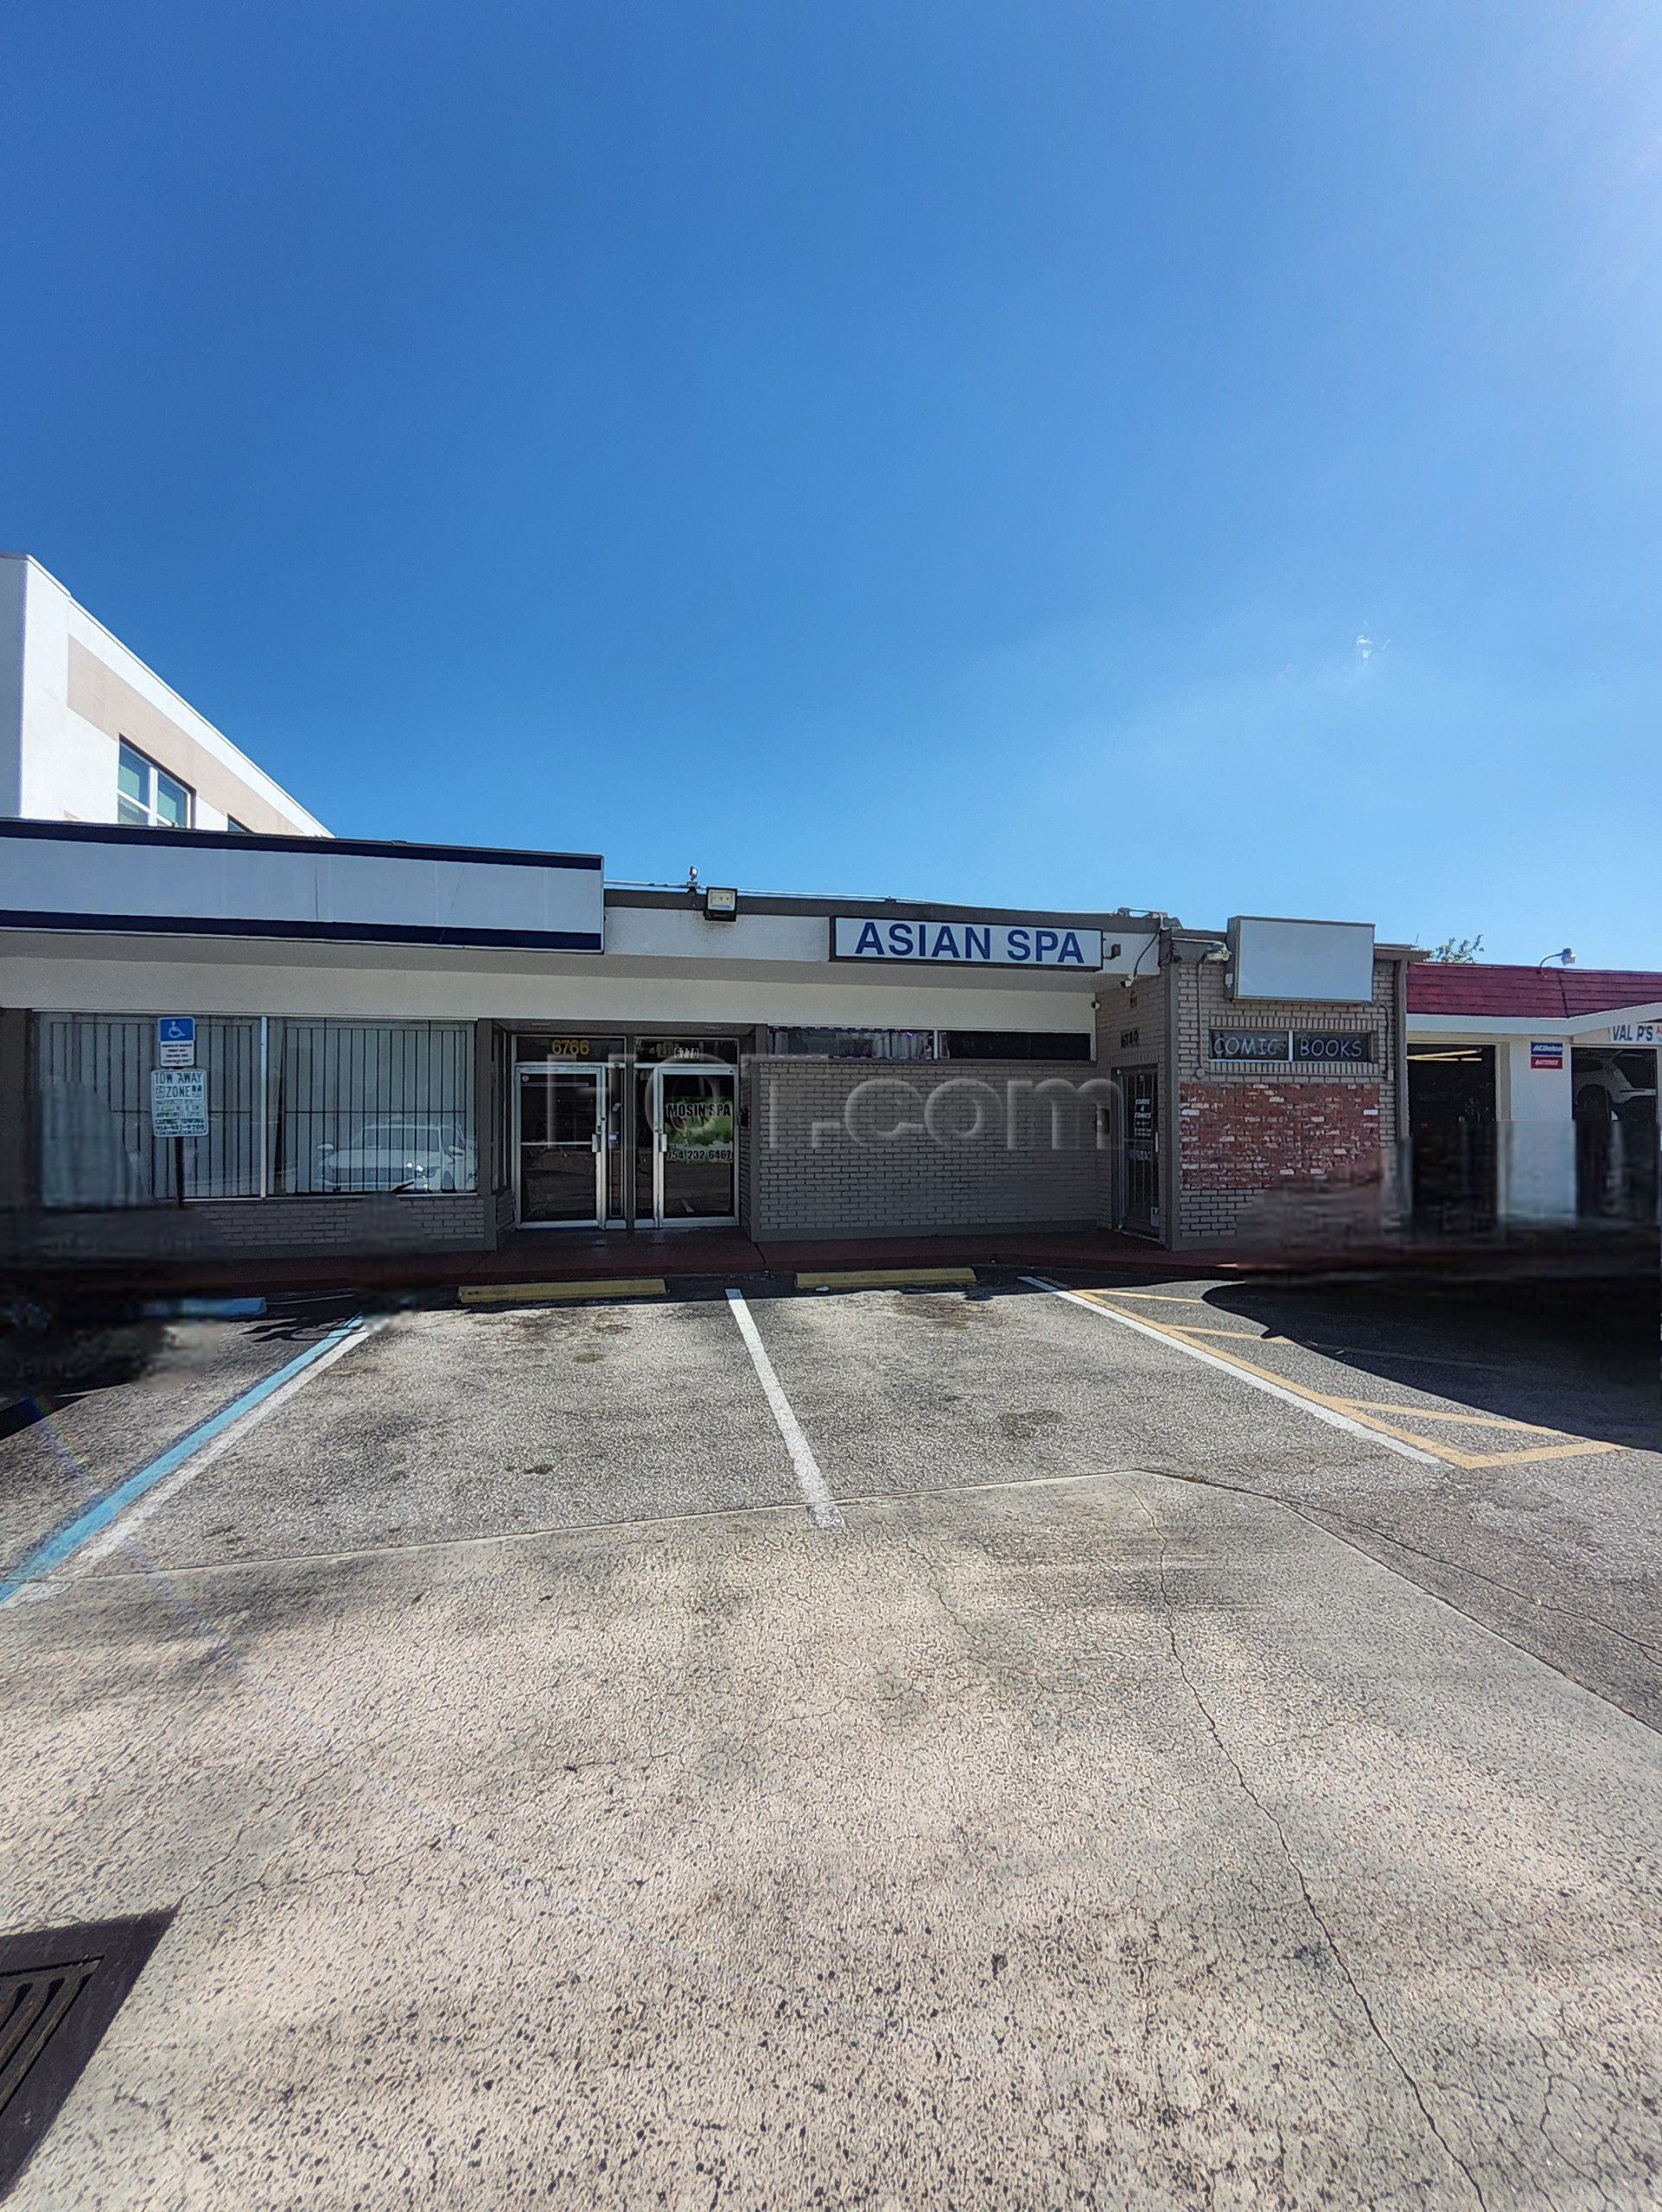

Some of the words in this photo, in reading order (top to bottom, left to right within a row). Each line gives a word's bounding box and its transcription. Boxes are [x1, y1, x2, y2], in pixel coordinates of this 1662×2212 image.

[854, 921, 990, 960] ASIAN
[1007, 930, 1085, 963] SPA
[1612, 1025, 1633, 1041] VAL
[551, 1039, 590, 1055] 6766
[675, 1048, 699, 1058] 6770
[1213, 1037, 1279, 1056] COMIC
[1300, 1038, 1363, 1058] BOOKS
[155, 1072, 174, 1084] TOW
[177, 1072, 202, 1084] AWAY
[166, 1085, 191, 1097] ZONE
[687, 1150, 705, 1160] 232
[709, 1150, 731, 1160] 6467
